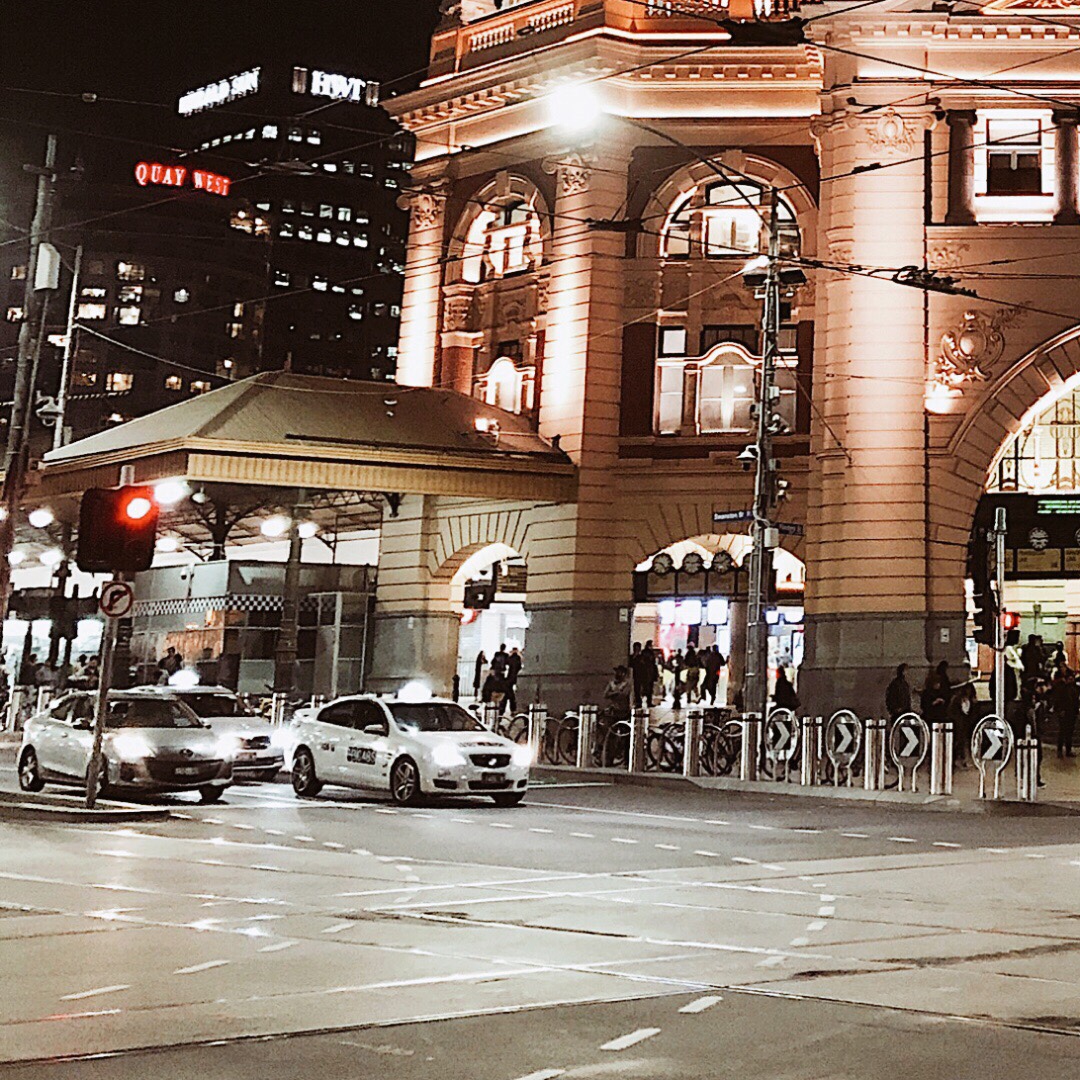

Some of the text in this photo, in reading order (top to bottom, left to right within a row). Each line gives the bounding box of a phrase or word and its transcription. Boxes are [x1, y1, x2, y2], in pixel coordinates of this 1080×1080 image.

[311, 70, 366, 102] HWT
[134, 163, 229, 196] QUAY WEST
